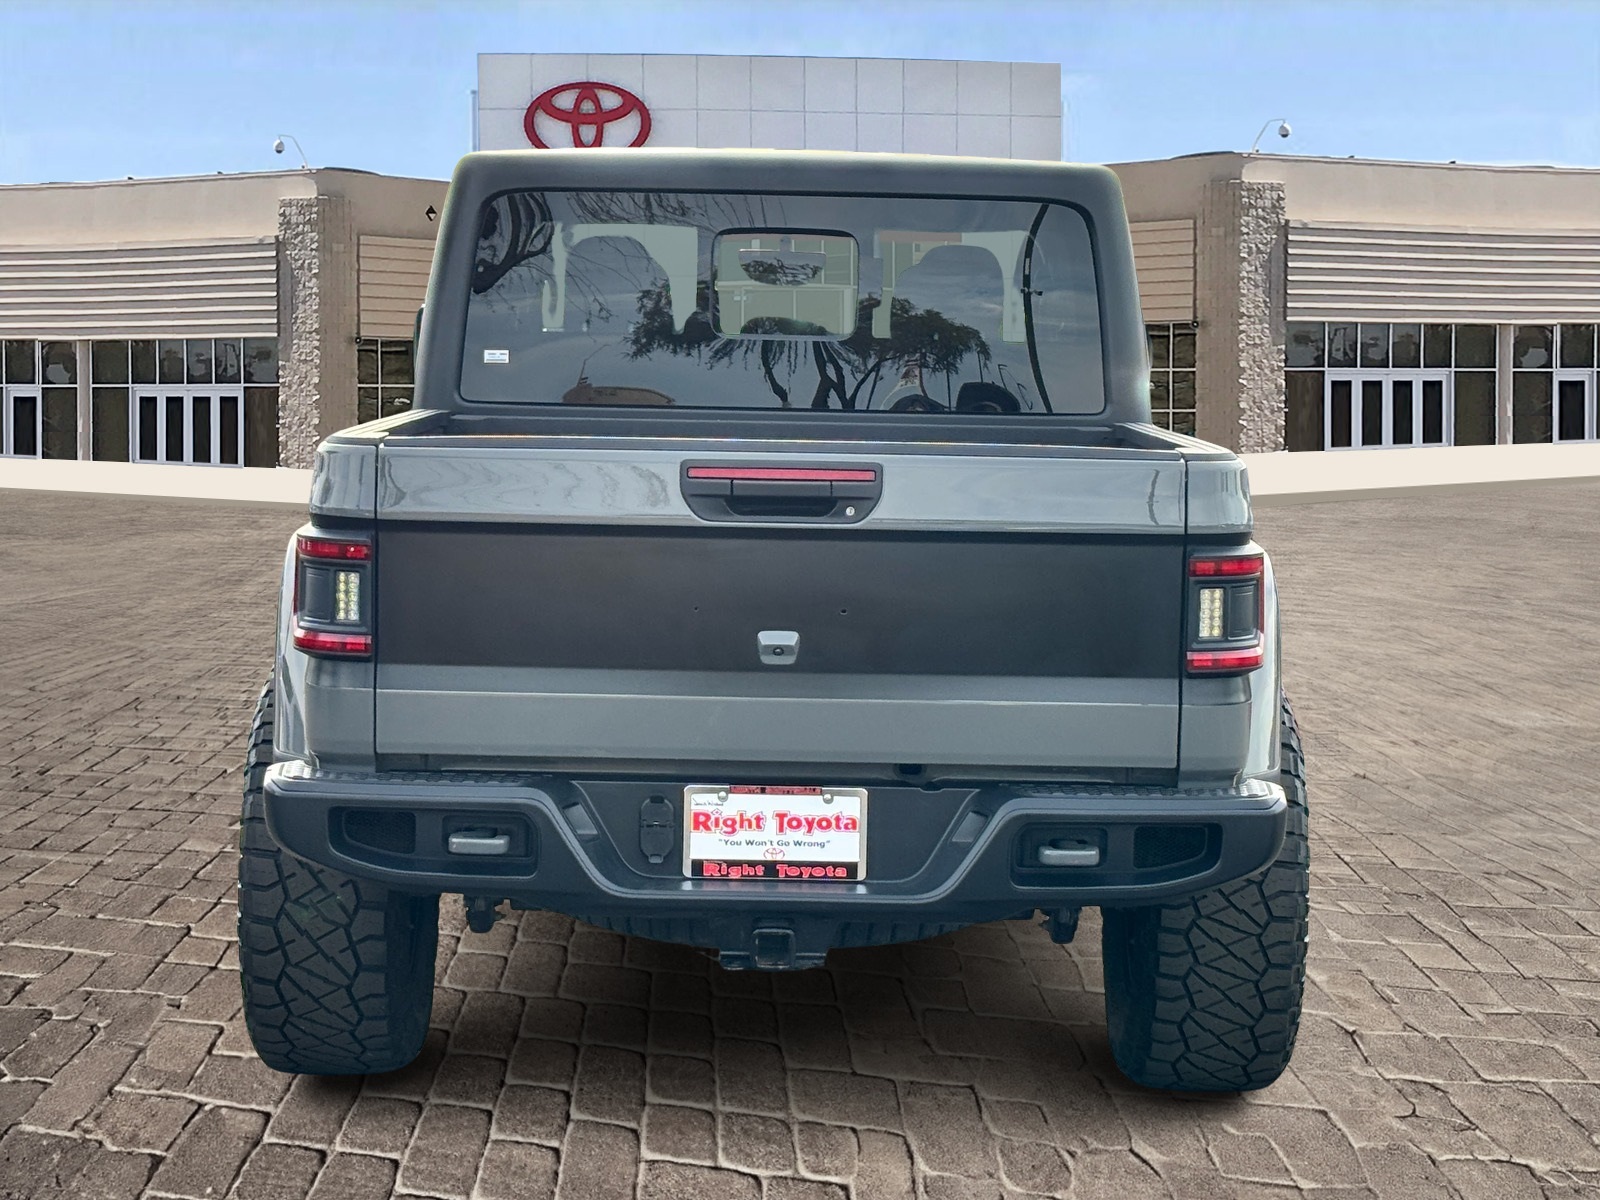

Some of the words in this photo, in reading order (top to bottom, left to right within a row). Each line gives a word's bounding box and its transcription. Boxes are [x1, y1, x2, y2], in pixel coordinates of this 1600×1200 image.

[691, 809, 766, 836] Right
[773, 810, 859, 835] Toyota
[718, 838, 742, 847] "You
[746, 839, 774, 847] Won't
[793, 840, 831, 849] Wrong"
[703, 863, 765, 877] Right
[776, 864, 848, 877] Toyota
